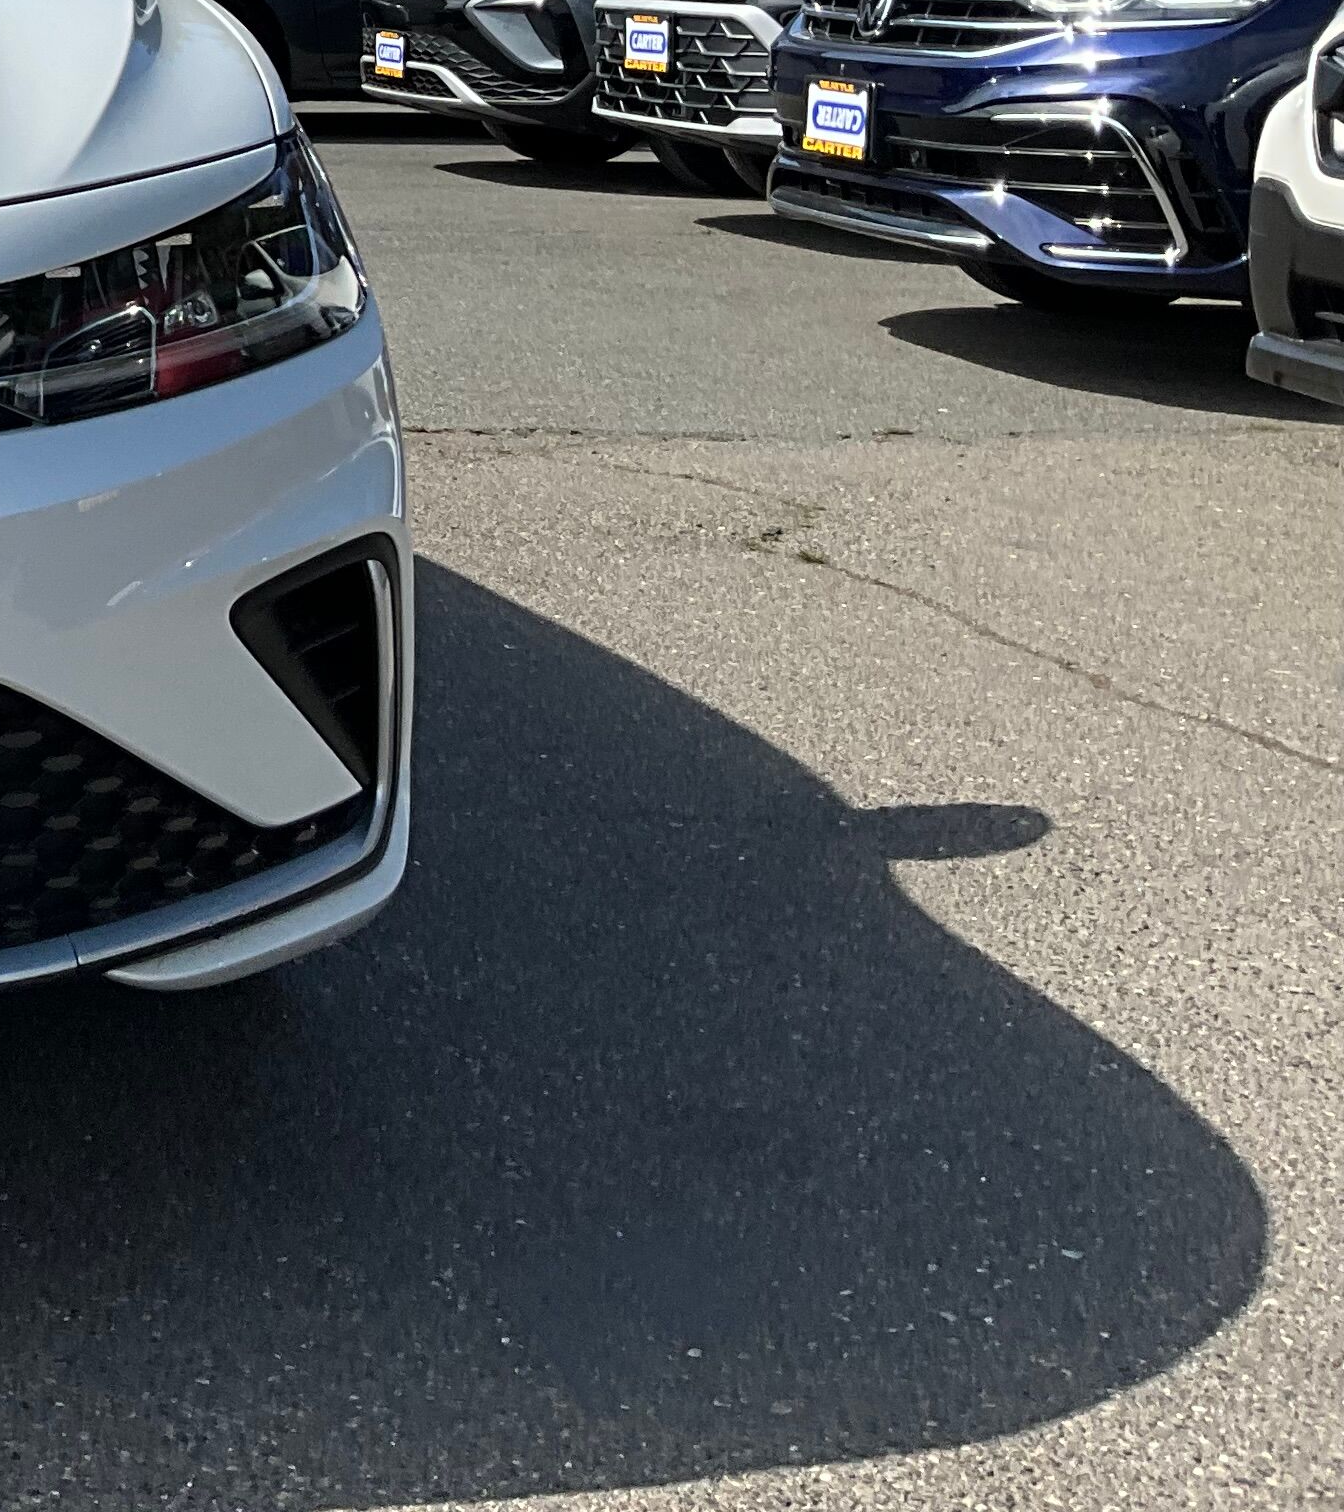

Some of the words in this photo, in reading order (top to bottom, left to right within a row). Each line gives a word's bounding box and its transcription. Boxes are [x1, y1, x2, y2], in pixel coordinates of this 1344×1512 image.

[633, 33, 663, 50] CARTER
[816, 104, 862, 132] CARTER
[802, 136, 863, 160] CARTER
